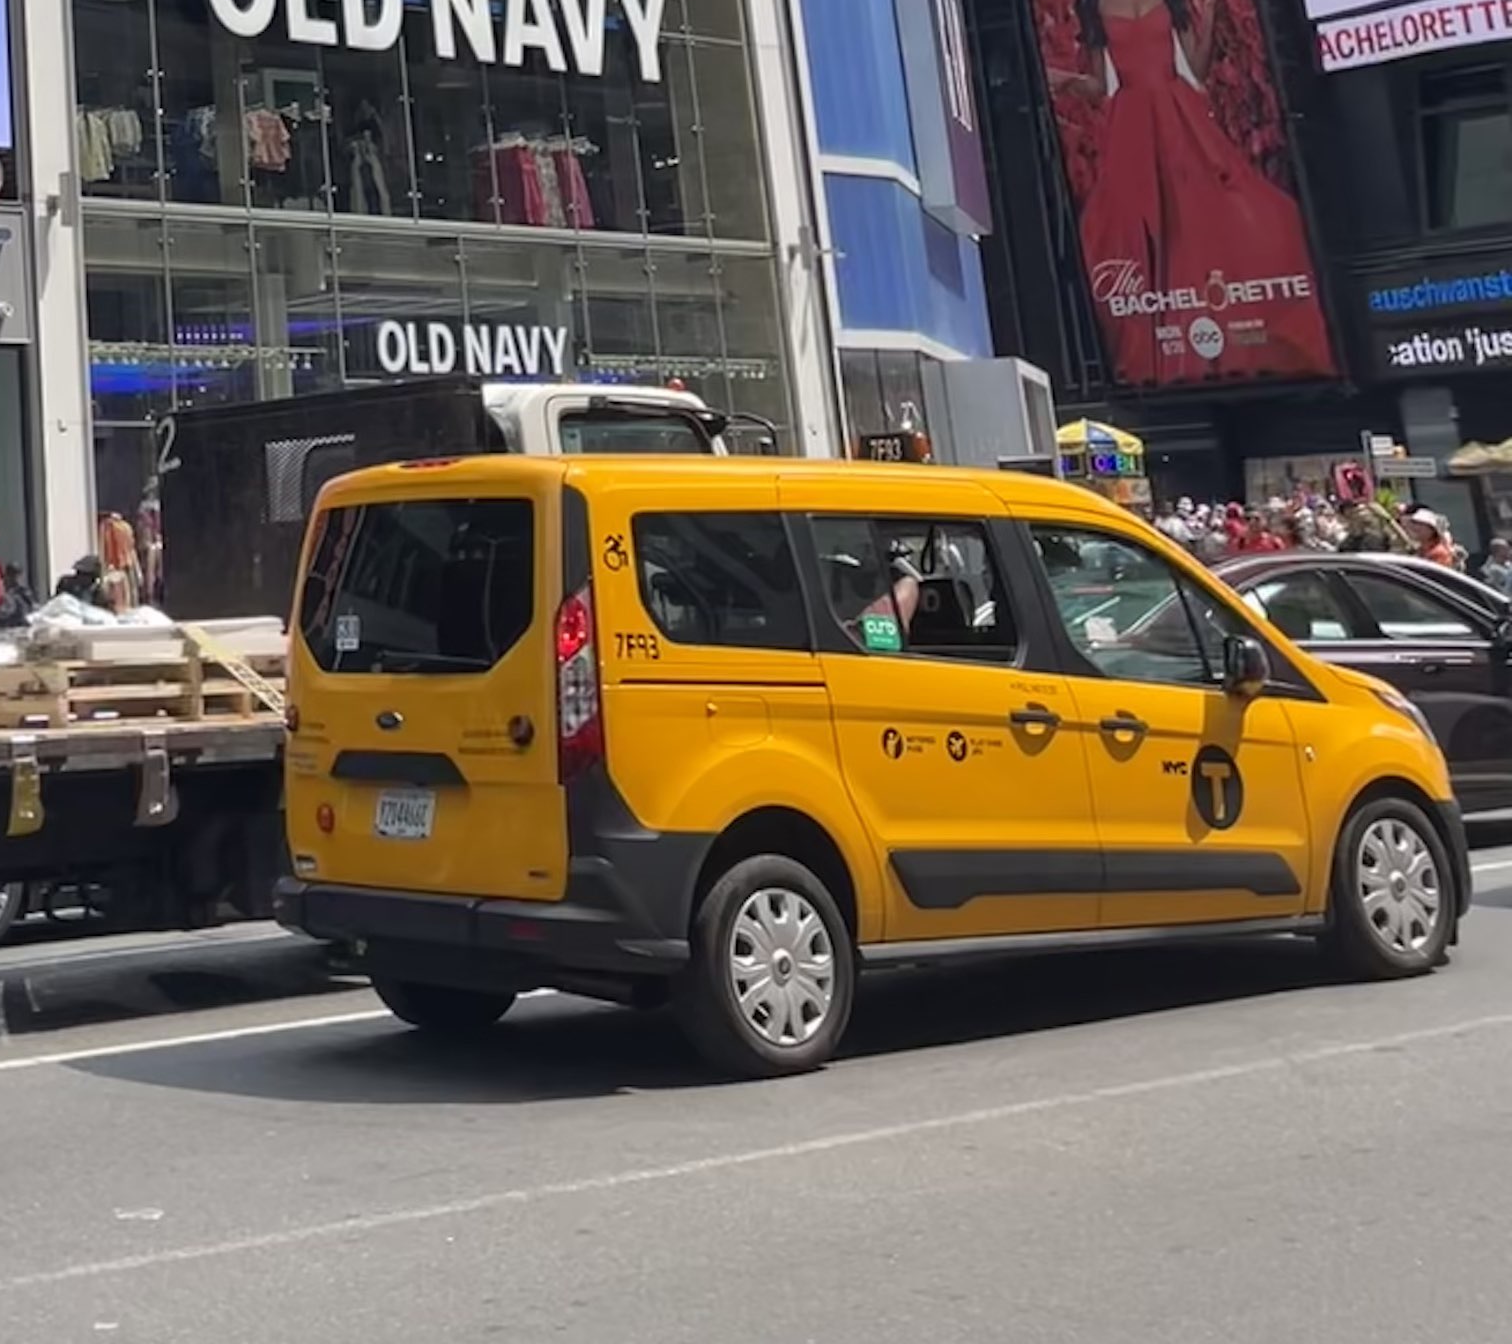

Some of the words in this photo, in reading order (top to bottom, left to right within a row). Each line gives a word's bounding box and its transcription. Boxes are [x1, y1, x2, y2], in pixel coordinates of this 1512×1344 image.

[377, 319, 455, 374] OLD
[463, 323, 568, 376] NAVY
[614, 631, 660, 660] 7F93
[1161, 760, 1188, 776] NYC
